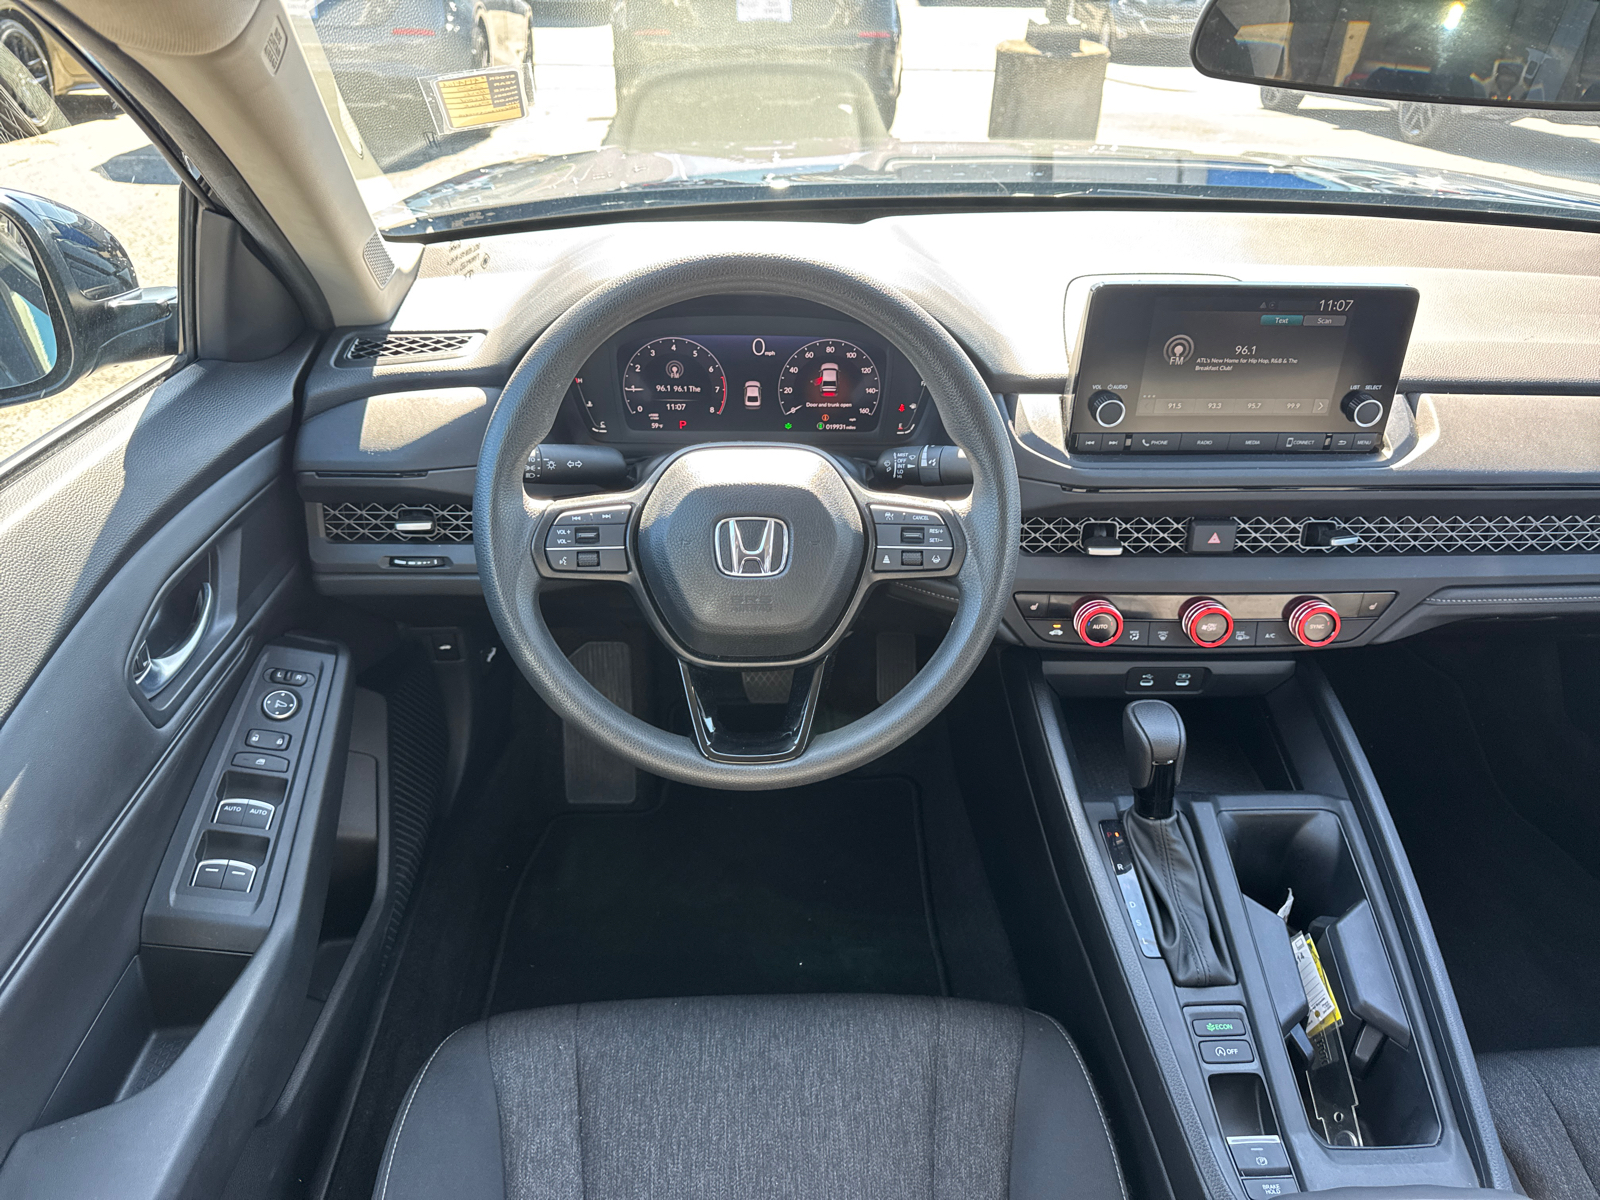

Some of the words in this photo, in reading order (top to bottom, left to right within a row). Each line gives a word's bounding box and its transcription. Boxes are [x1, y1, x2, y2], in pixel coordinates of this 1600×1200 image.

[1319, 299, 1354, 312] 11:07
[1275, 317, 1289, 325] Text
[1317, 317, 1332, 325] Scan
[752, 338, 766, 356] 0
[825, 346, 835, 354] 80
[1235, 345, 1257, 355] 96.1
[804, 351, 814, 359] 60
[1169, 356, 1184, 366] FM
[789, 366, 799, 374] 40
[666, 403, 686, 411] 11:07
[679, 421, 687, 429] P
[250, 808, 267, 816] AUTO
[1117, 863, 1124, 871] R
[1136, 919, 1142, 927] S
[1141, 937, 1149, 945] L
